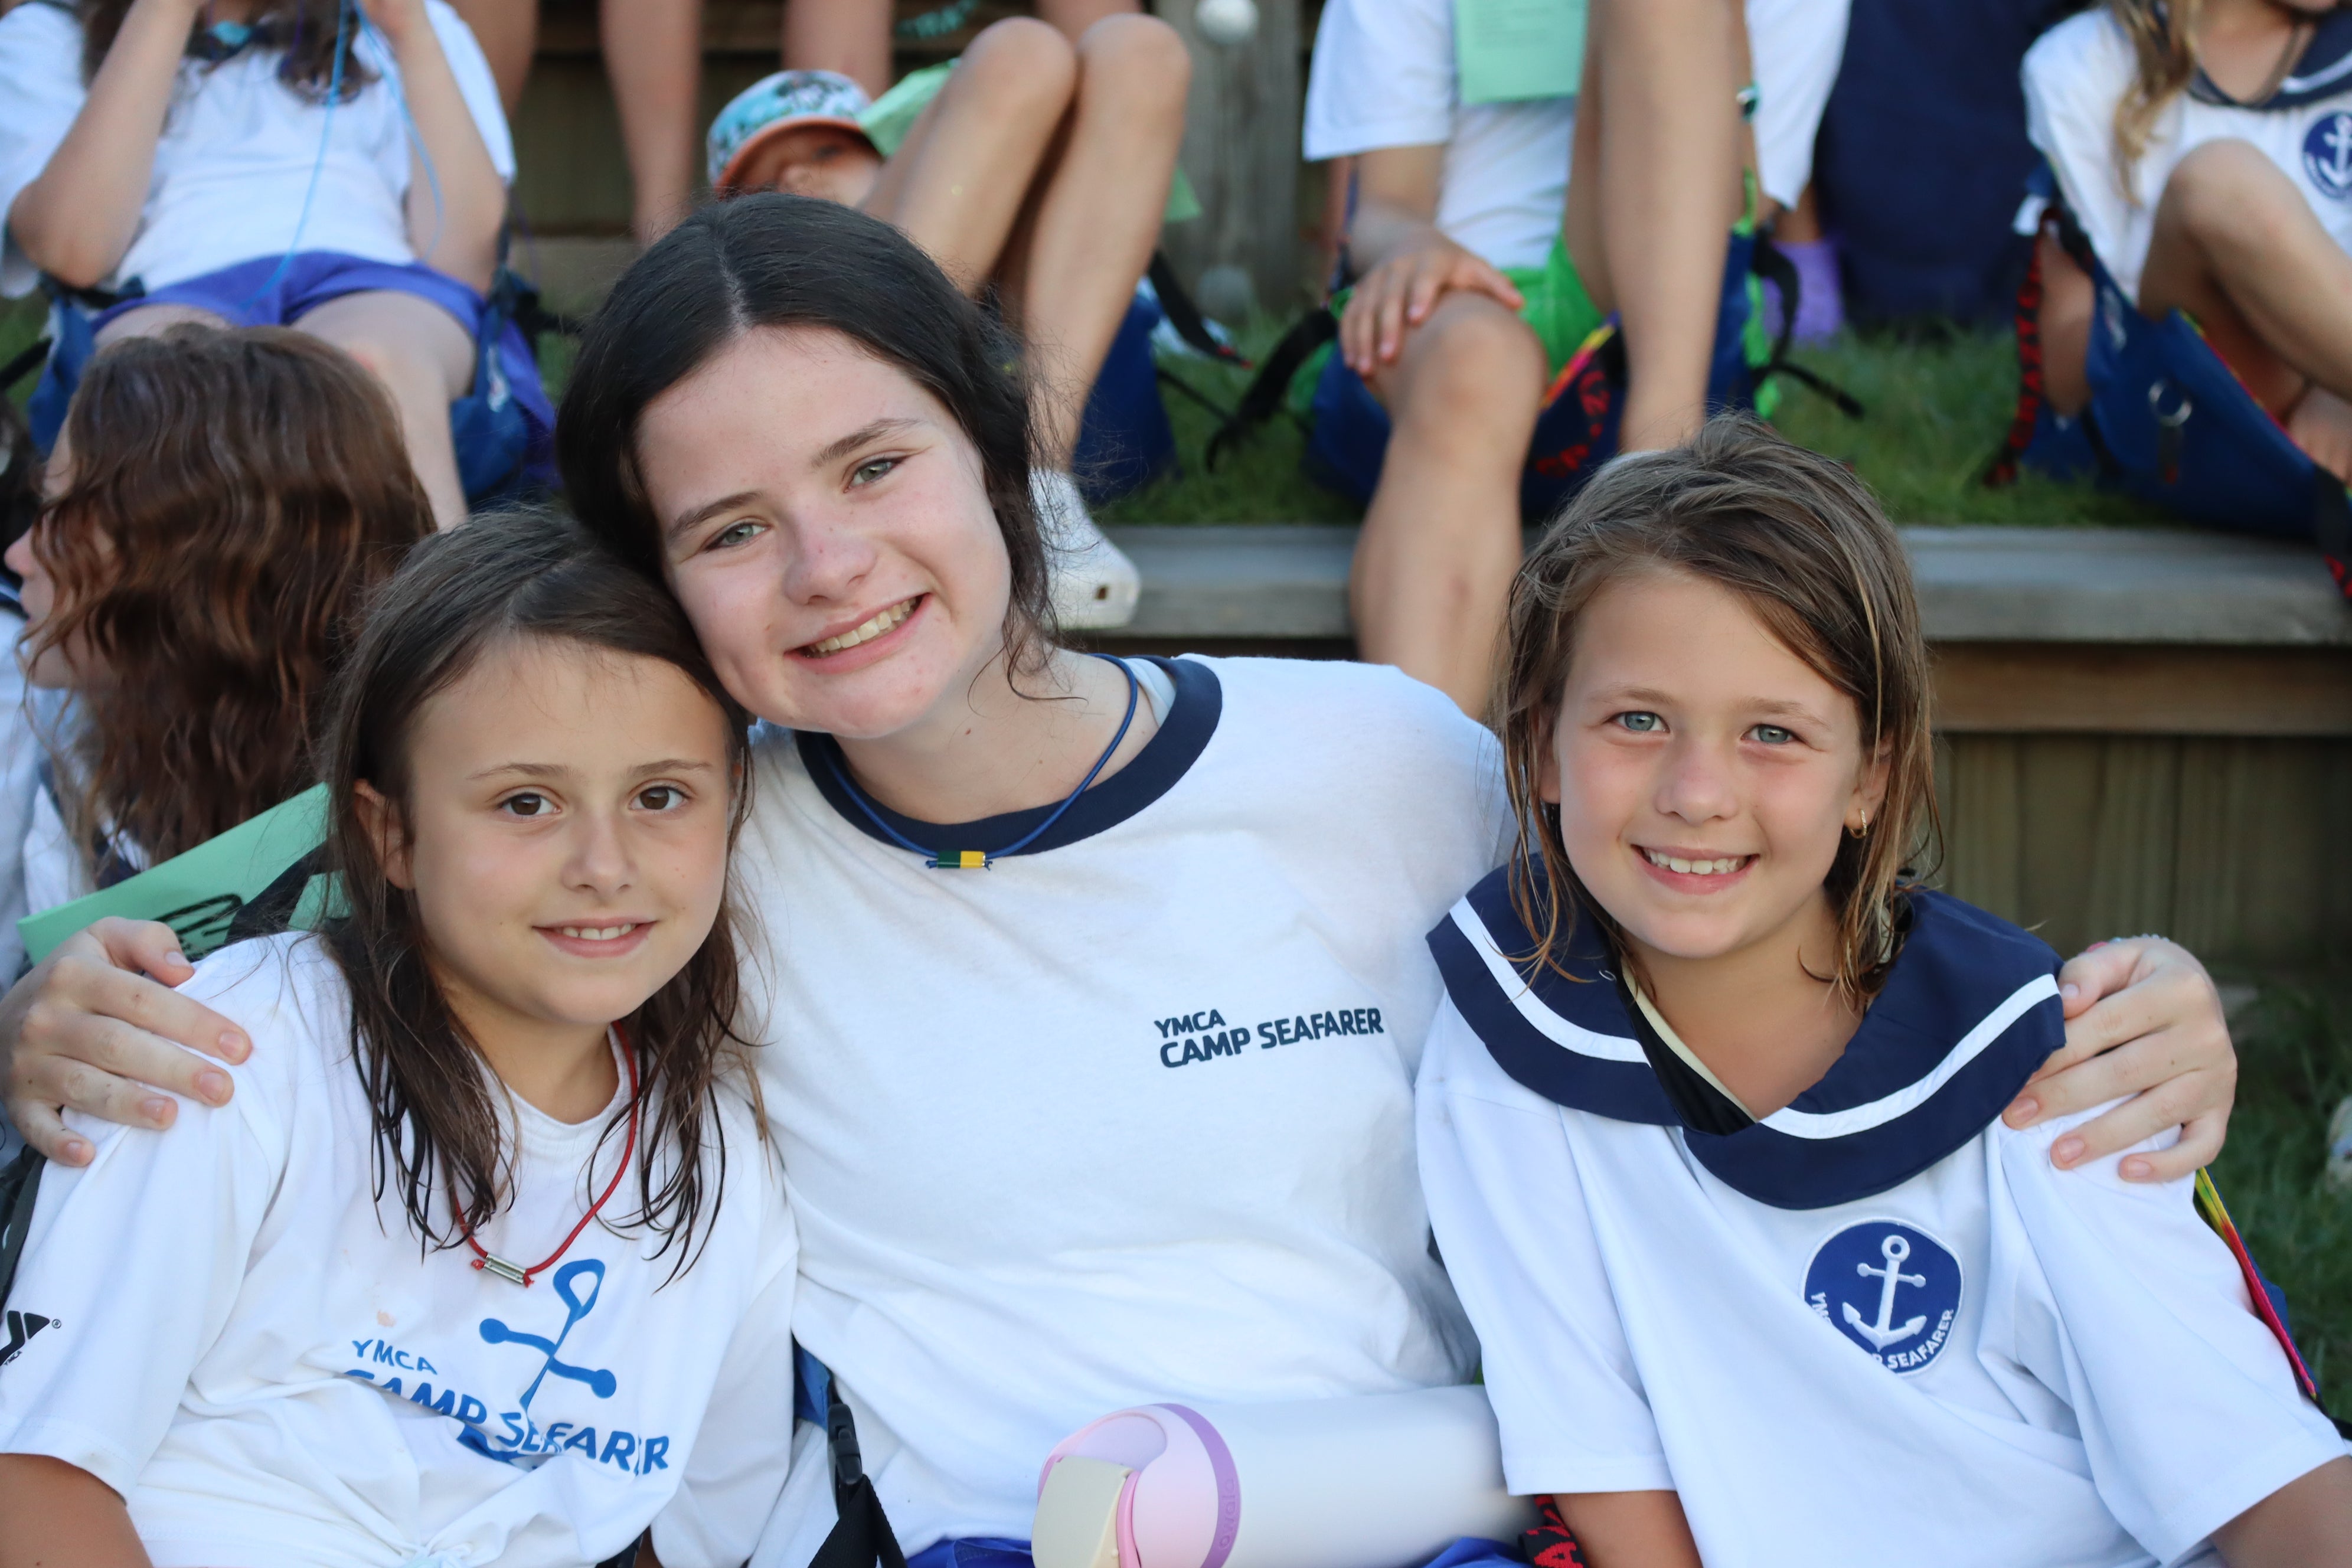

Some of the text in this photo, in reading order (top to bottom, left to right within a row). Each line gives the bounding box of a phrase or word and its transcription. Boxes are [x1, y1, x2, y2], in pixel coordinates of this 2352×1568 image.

[1154, 1009, 1226, 1038] YMCA
[1160, 1008, 1384, 1067] CAMP SEAFARER
[4, 1350, 22, 1366] YMCA
[352, 1339, 437, 1375] YMCA
[1887, 1309, 1954, 1369] SEAFARER
[344, 1369, 669, 1476] MP SEFARR
